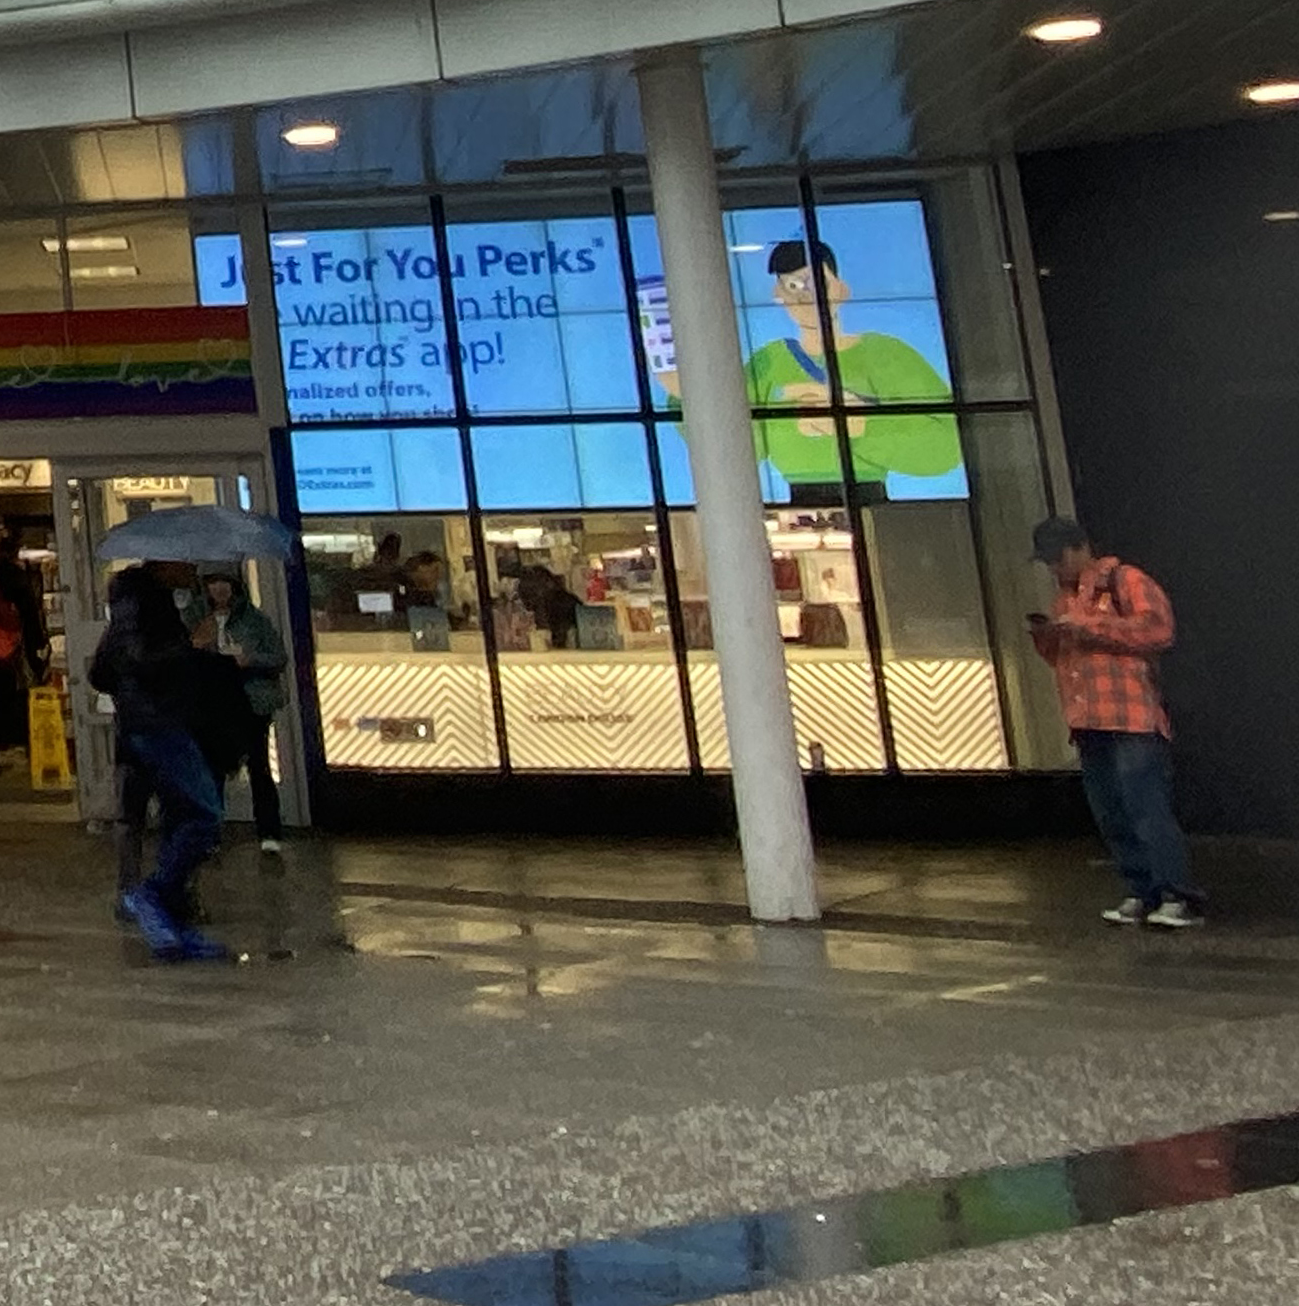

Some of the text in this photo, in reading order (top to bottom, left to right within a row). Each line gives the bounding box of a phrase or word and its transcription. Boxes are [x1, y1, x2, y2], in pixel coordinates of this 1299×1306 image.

[312, 250, 379, 285] For
[294, 296, 434, 333] waiting
[490, 286, 558, 320] the
